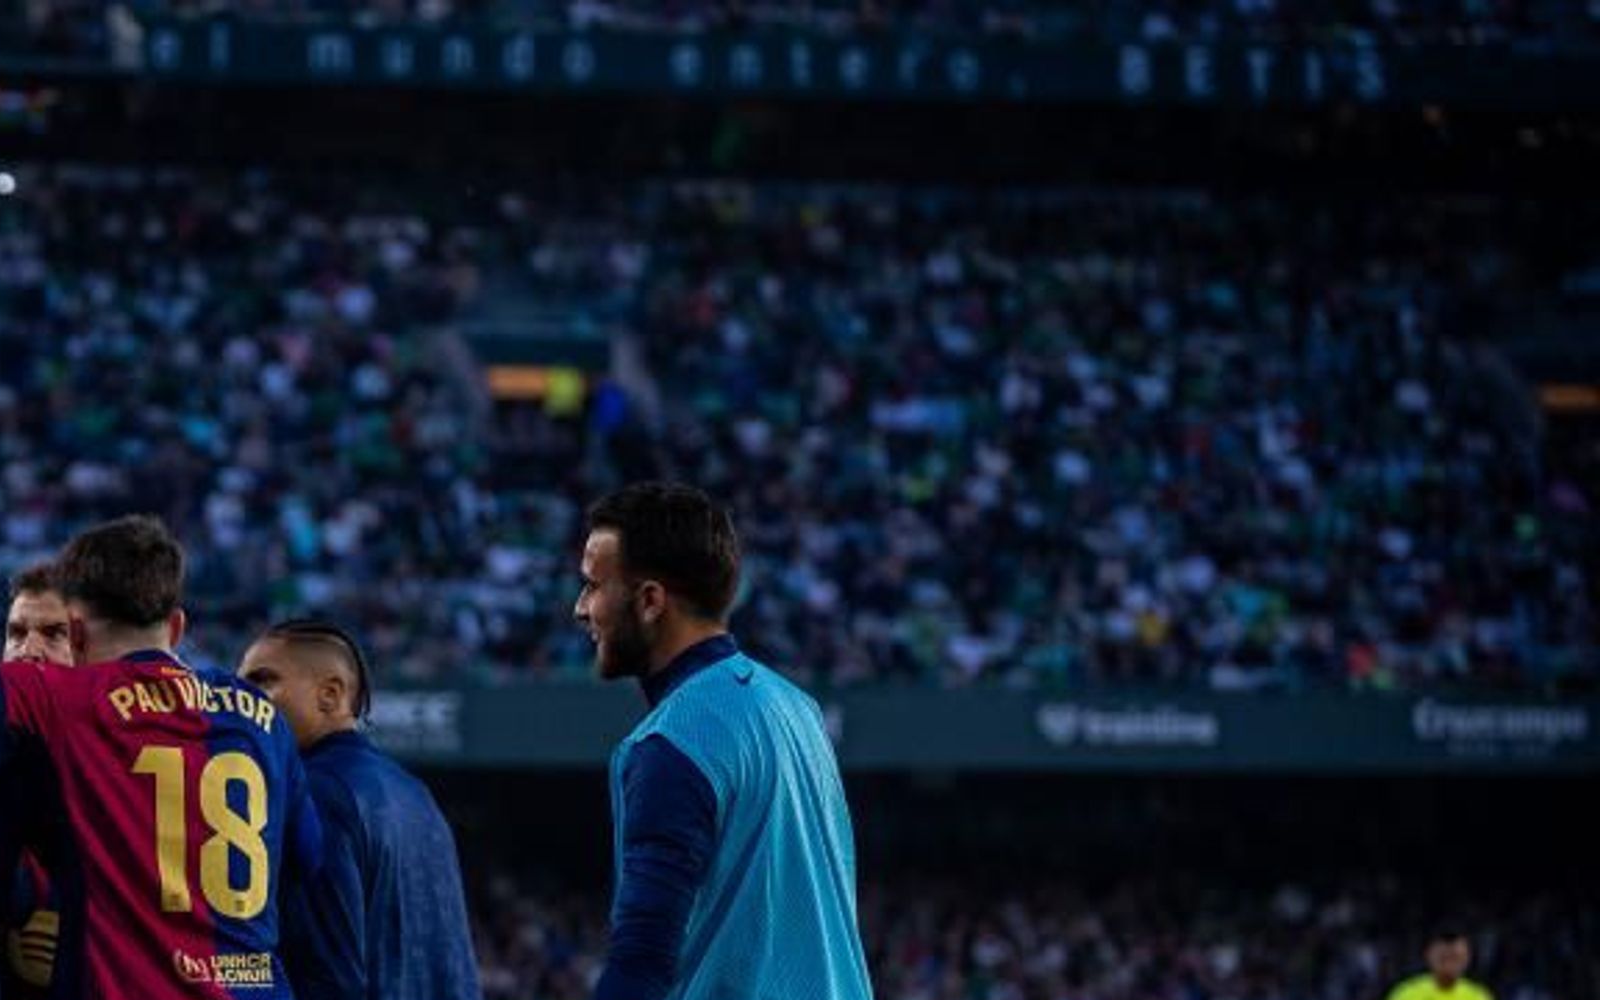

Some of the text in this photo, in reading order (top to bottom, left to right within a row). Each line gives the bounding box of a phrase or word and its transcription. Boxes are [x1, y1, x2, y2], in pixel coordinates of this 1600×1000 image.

[150, 21, 231, 72] el
[305, 32, 596, 84] mundo
[1118, 43, 1385, 98] BETIS
[109, 680, 176, 721] PAU
[130, 744, 269, 921] 18
[209, 952, 271, 968] UNHCR
[214, 967, 274, 983] ACNUR
